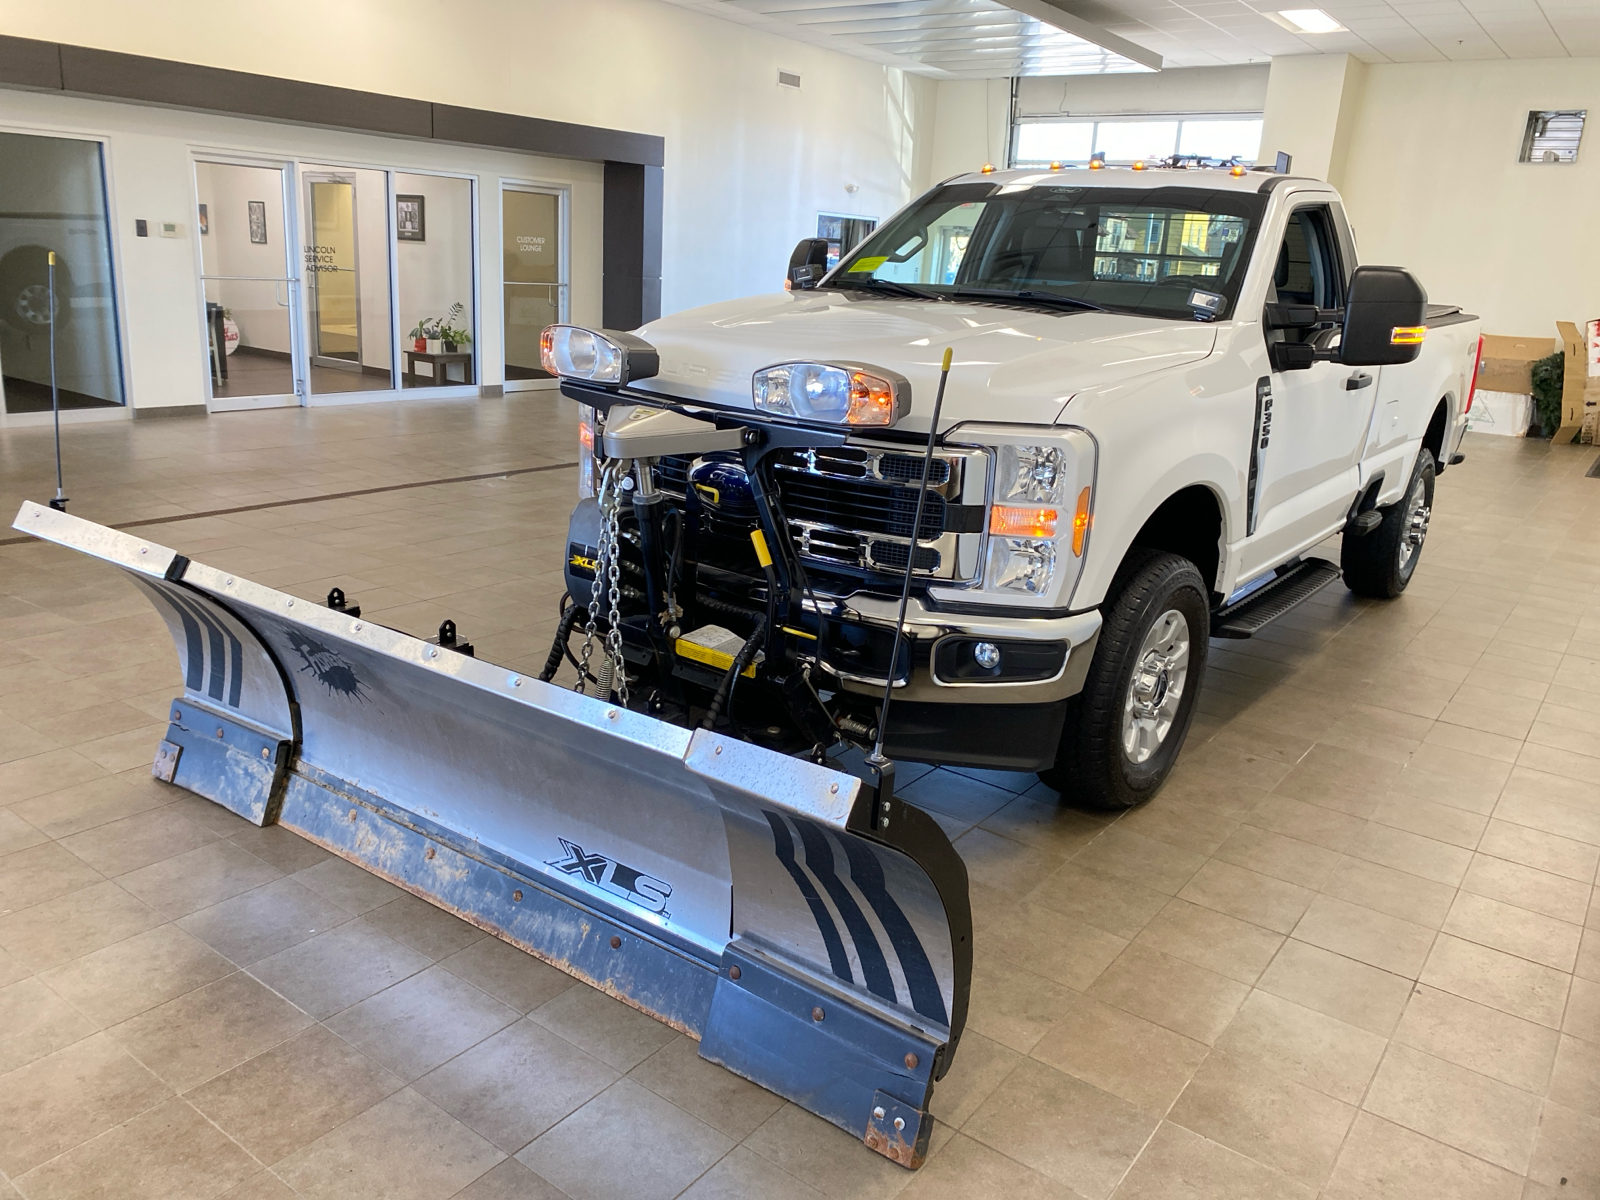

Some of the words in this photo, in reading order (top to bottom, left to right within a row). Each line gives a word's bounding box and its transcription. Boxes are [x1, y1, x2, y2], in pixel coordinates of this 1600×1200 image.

[516, 236, 546, 245] CUSTOMER
[303, 245, 336, 254] LINCOLN
[520, 244, 542, 252] LOUNGE
[304, 255, 334, 263] SERVICE
[305, 265, 338, 273] ADVISOR
[660, 359, 753, 388] UPER
[542, 836, 673, 917] XLS
